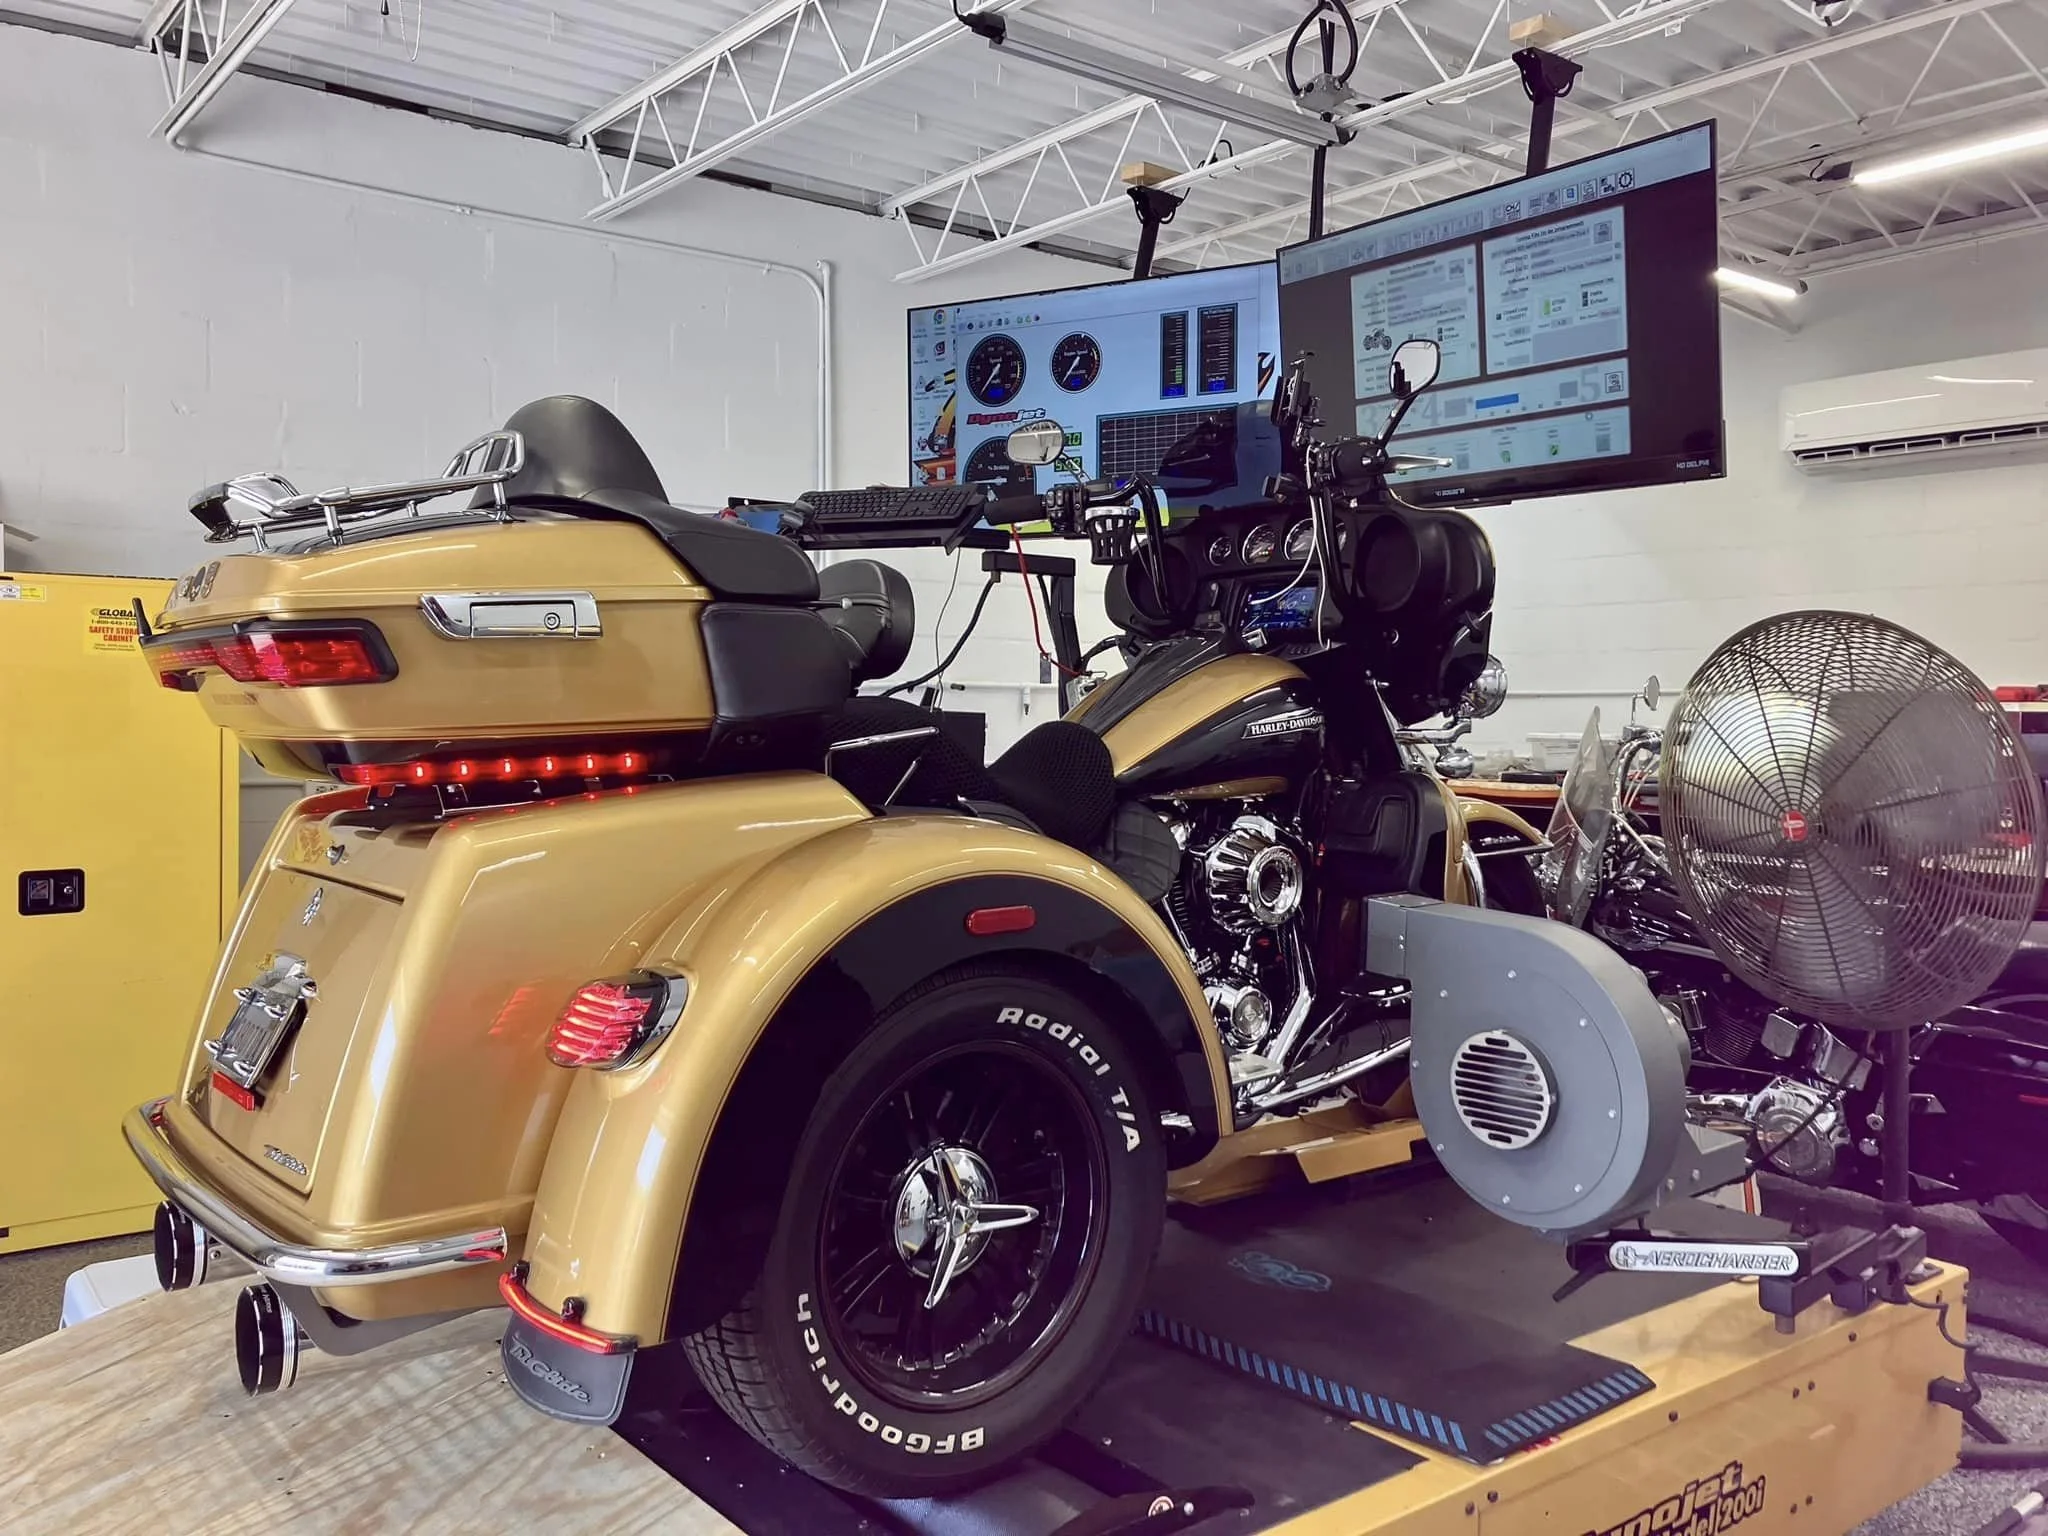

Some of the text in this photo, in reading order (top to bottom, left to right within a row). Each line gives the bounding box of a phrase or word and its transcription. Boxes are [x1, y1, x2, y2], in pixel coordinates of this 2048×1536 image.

[966, 408, 1046, 426] Dynojet
[103, 634, 133, 642] CABINET
[996, 1007, 1141, 1152] Radial T/A
[1646, 1250, 1794, 1271] AEROCHARGER
[797, 1293, 985, 1455] BFGoodrich
[1718, 1474, 1766, 1533] 200i
